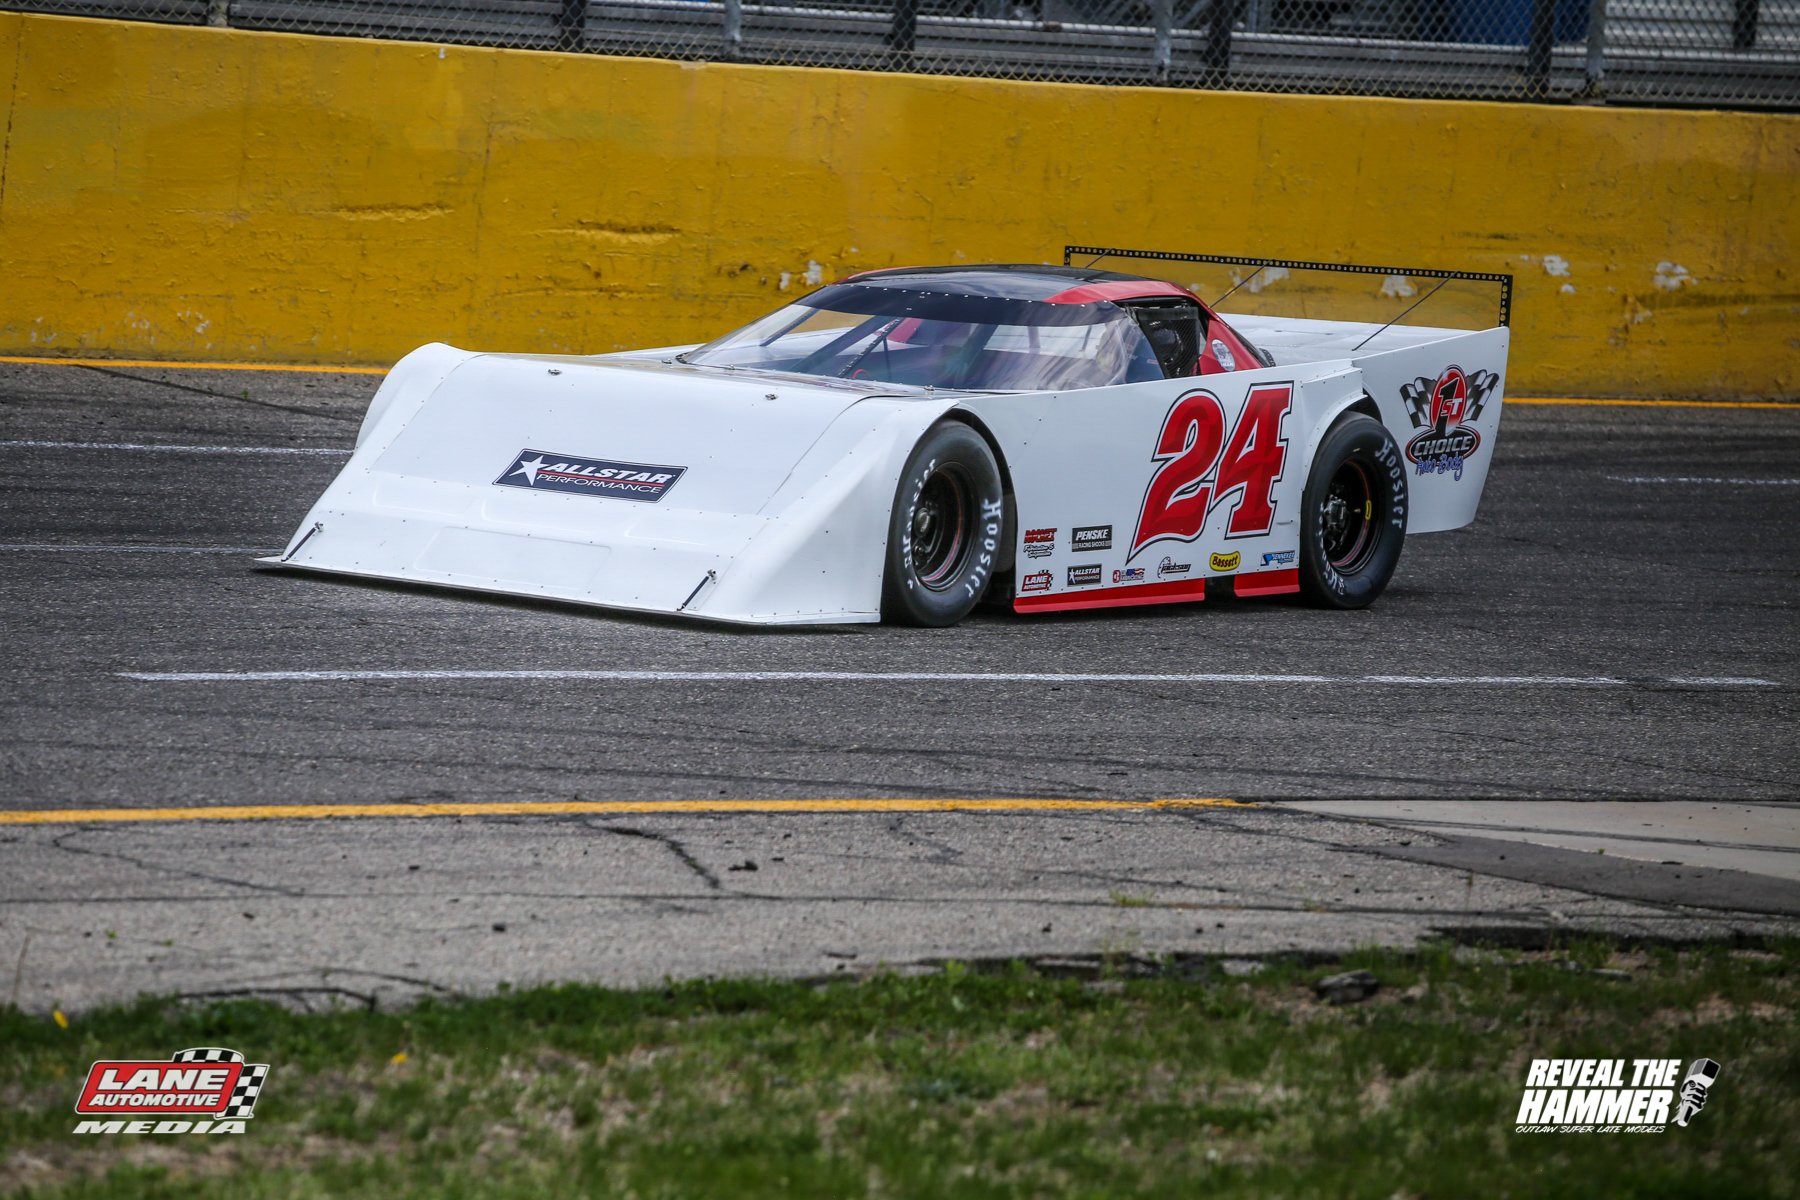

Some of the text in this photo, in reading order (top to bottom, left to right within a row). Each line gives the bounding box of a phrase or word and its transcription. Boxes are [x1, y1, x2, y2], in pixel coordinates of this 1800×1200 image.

[1413, 435, 1473, 456] CHOICE
[543, 462, 672, 484] ALLSTAR
[1127, 380, 1294, 565] 24
[536, 473, 663, 494] PERFORMANCE
[1075, 529, 1109, 541] PENSKE
[1212, 555, 1239, 568] Bassett
[1025, 575, 1048, 584] LANE
[1074, 568, 1100, 576] ALLSTAR
